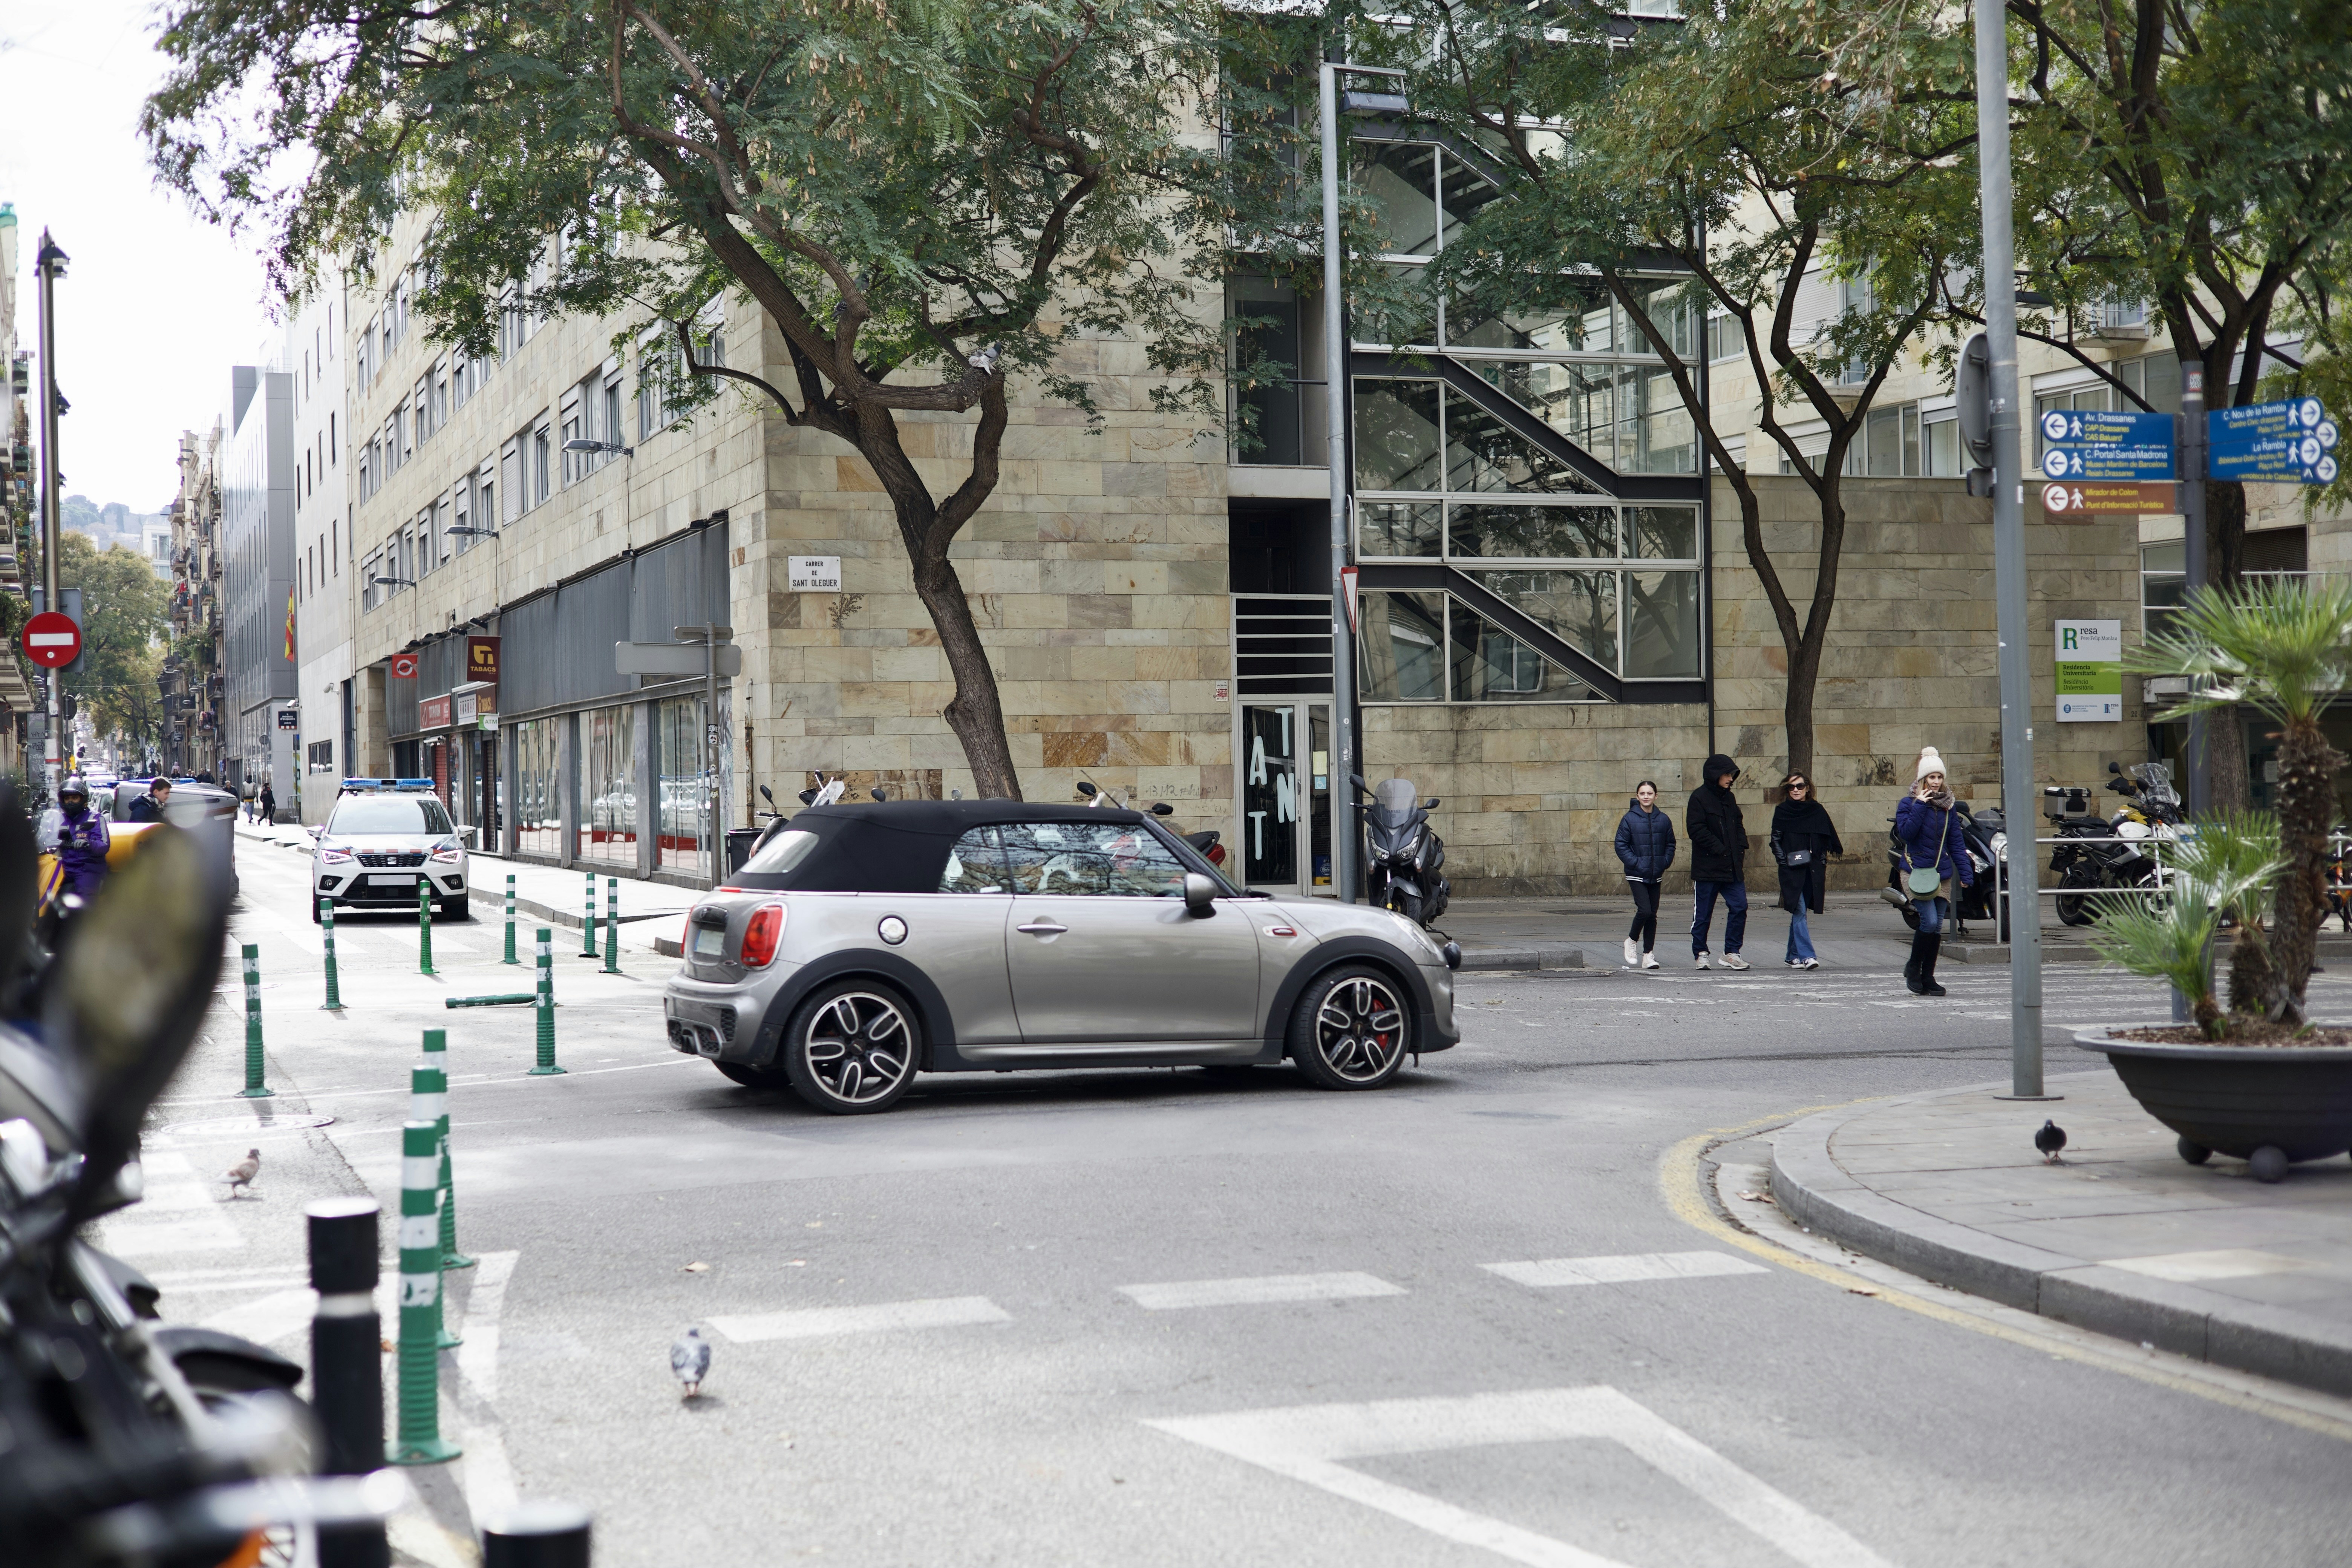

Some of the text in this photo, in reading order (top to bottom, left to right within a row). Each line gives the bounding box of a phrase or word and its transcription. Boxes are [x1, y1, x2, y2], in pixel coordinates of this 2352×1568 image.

[2085, 412, 2136, 423] Av. Drassanes
[2224, 404, 2286, 420] C. Nou de la Rambla
[2253, 440, 2286, 452] La Rambla
[2086, 450, 2168, 459] C. Portal Santa Madrona
[2274, 473, 2301, 482] Catalunya
